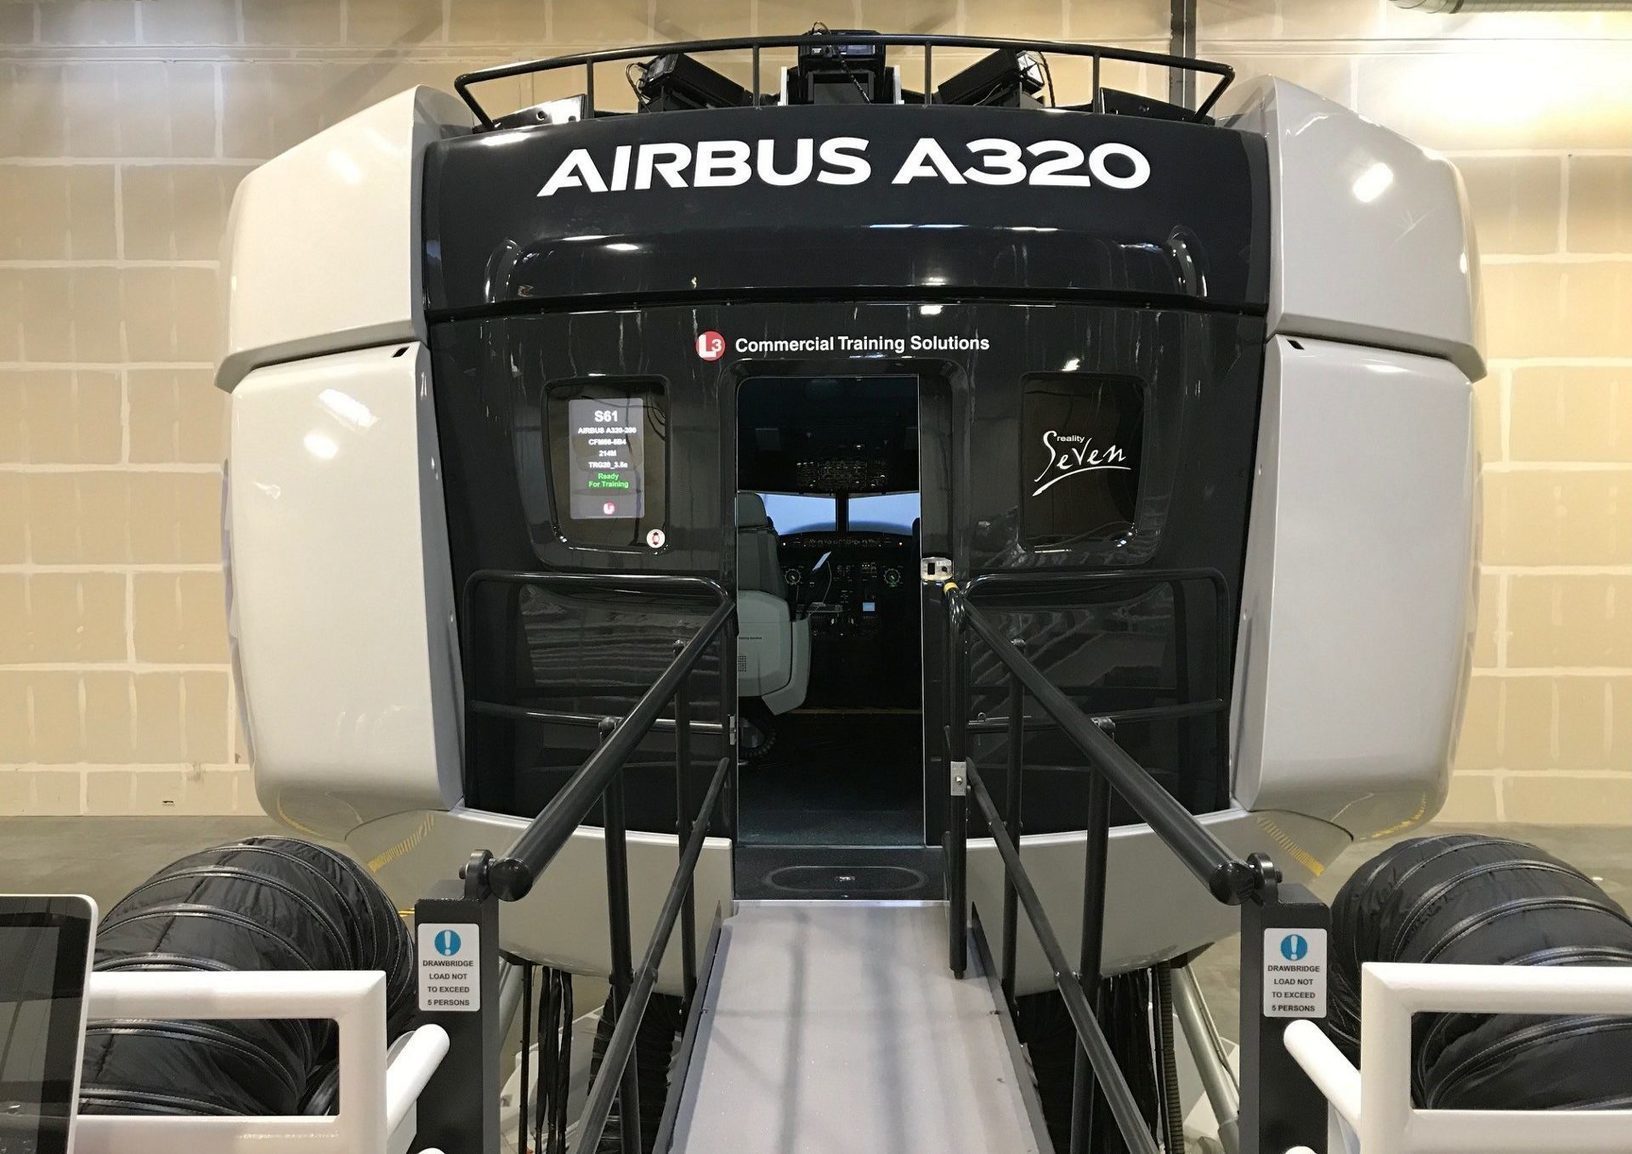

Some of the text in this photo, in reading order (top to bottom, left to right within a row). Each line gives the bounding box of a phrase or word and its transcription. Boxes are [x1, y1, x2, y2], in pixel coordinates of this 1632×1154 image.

[536, 136, 1151, 197] AIRBUS A320
[698, 334, 990, 358] L3 Commercial Training Solutions
[594, 410, 618, 422] S61
[1056, 435, 1085, 443] reality
[602, 481, 629, 489] Training
